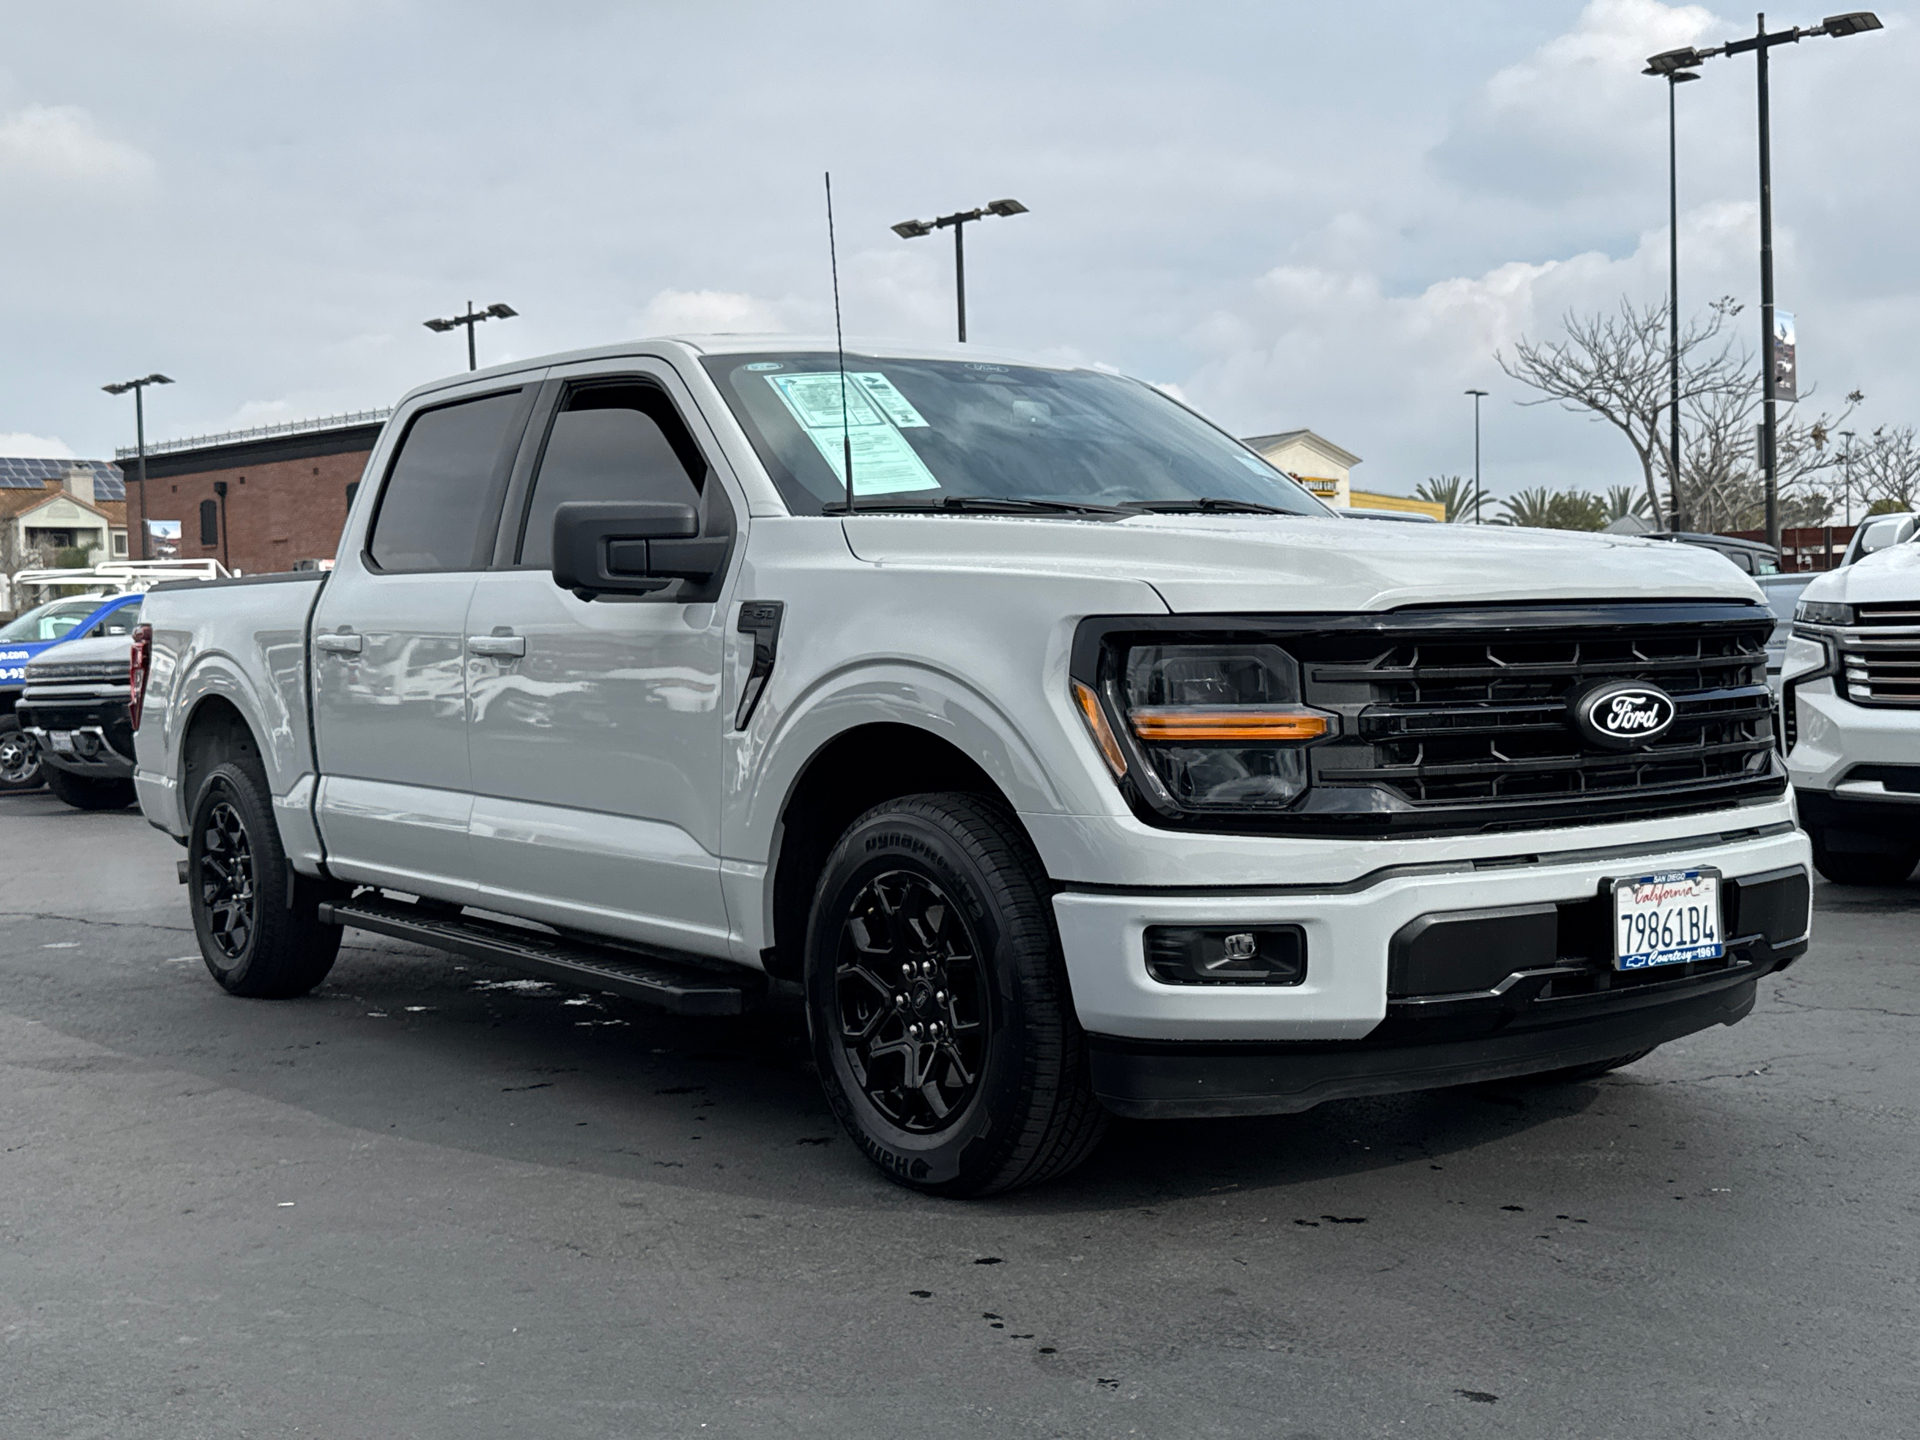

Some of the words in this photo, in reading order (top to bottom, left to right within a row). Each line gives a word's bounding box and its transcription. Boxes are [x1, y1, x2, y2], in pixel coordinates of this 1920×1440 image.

[0, 651, 29, 662] e.com
[1607, 696, 1660, 730] Ford
[1653, 875, 1666, 884] SAN
[1667, 873, 1686, 882] DIEGO
[1635, 884, 1700, 907] California
[1621, 905, 1715, 954] 79861B4
